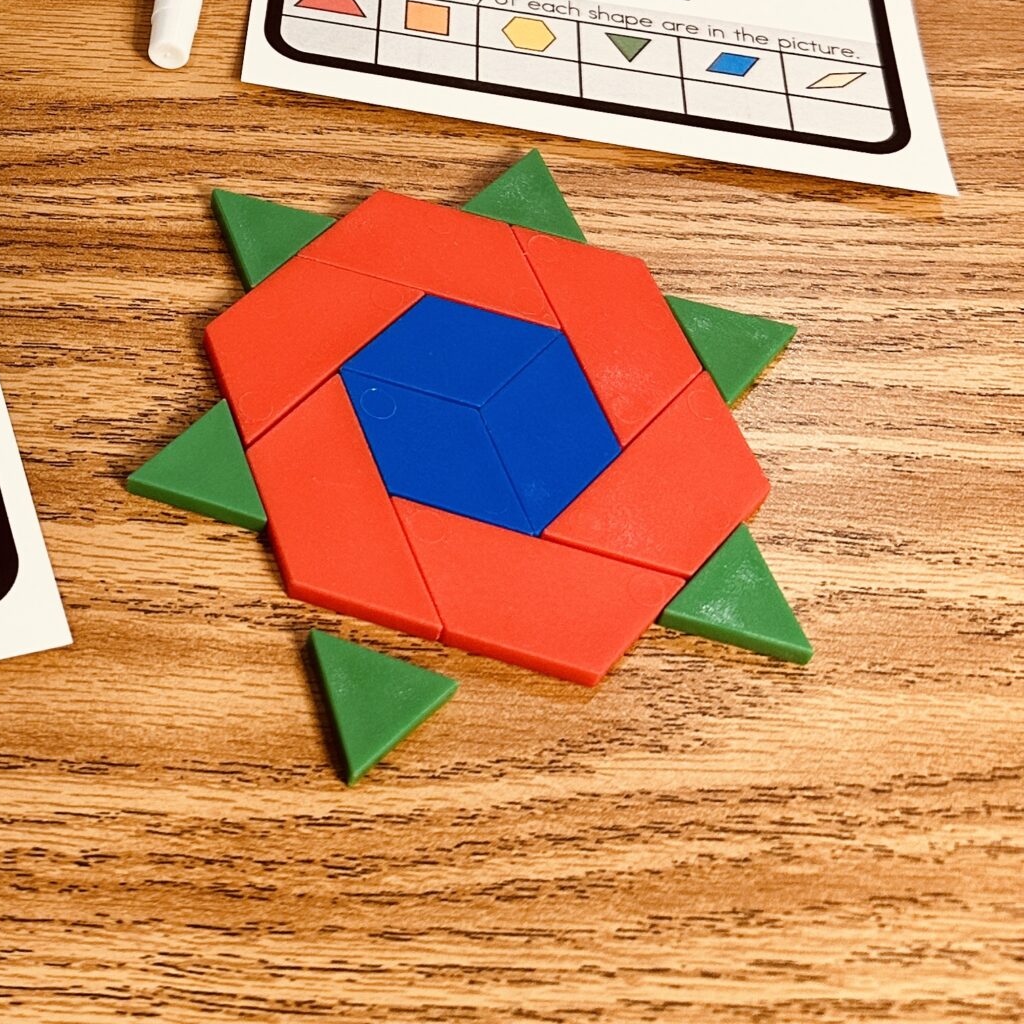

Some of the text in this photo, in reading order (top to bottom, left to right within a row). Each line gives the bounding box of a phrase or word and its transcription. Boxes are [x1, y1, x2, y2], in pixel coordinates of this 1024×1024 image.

[527, 0, 580, 17] each
[588, 5, 653, 29] shape
[662, 20, 699, 35] are
[708, 25, 725, 39] in
[733, 27, 769, 45] the
[778, 37, 861, 60] picture.
